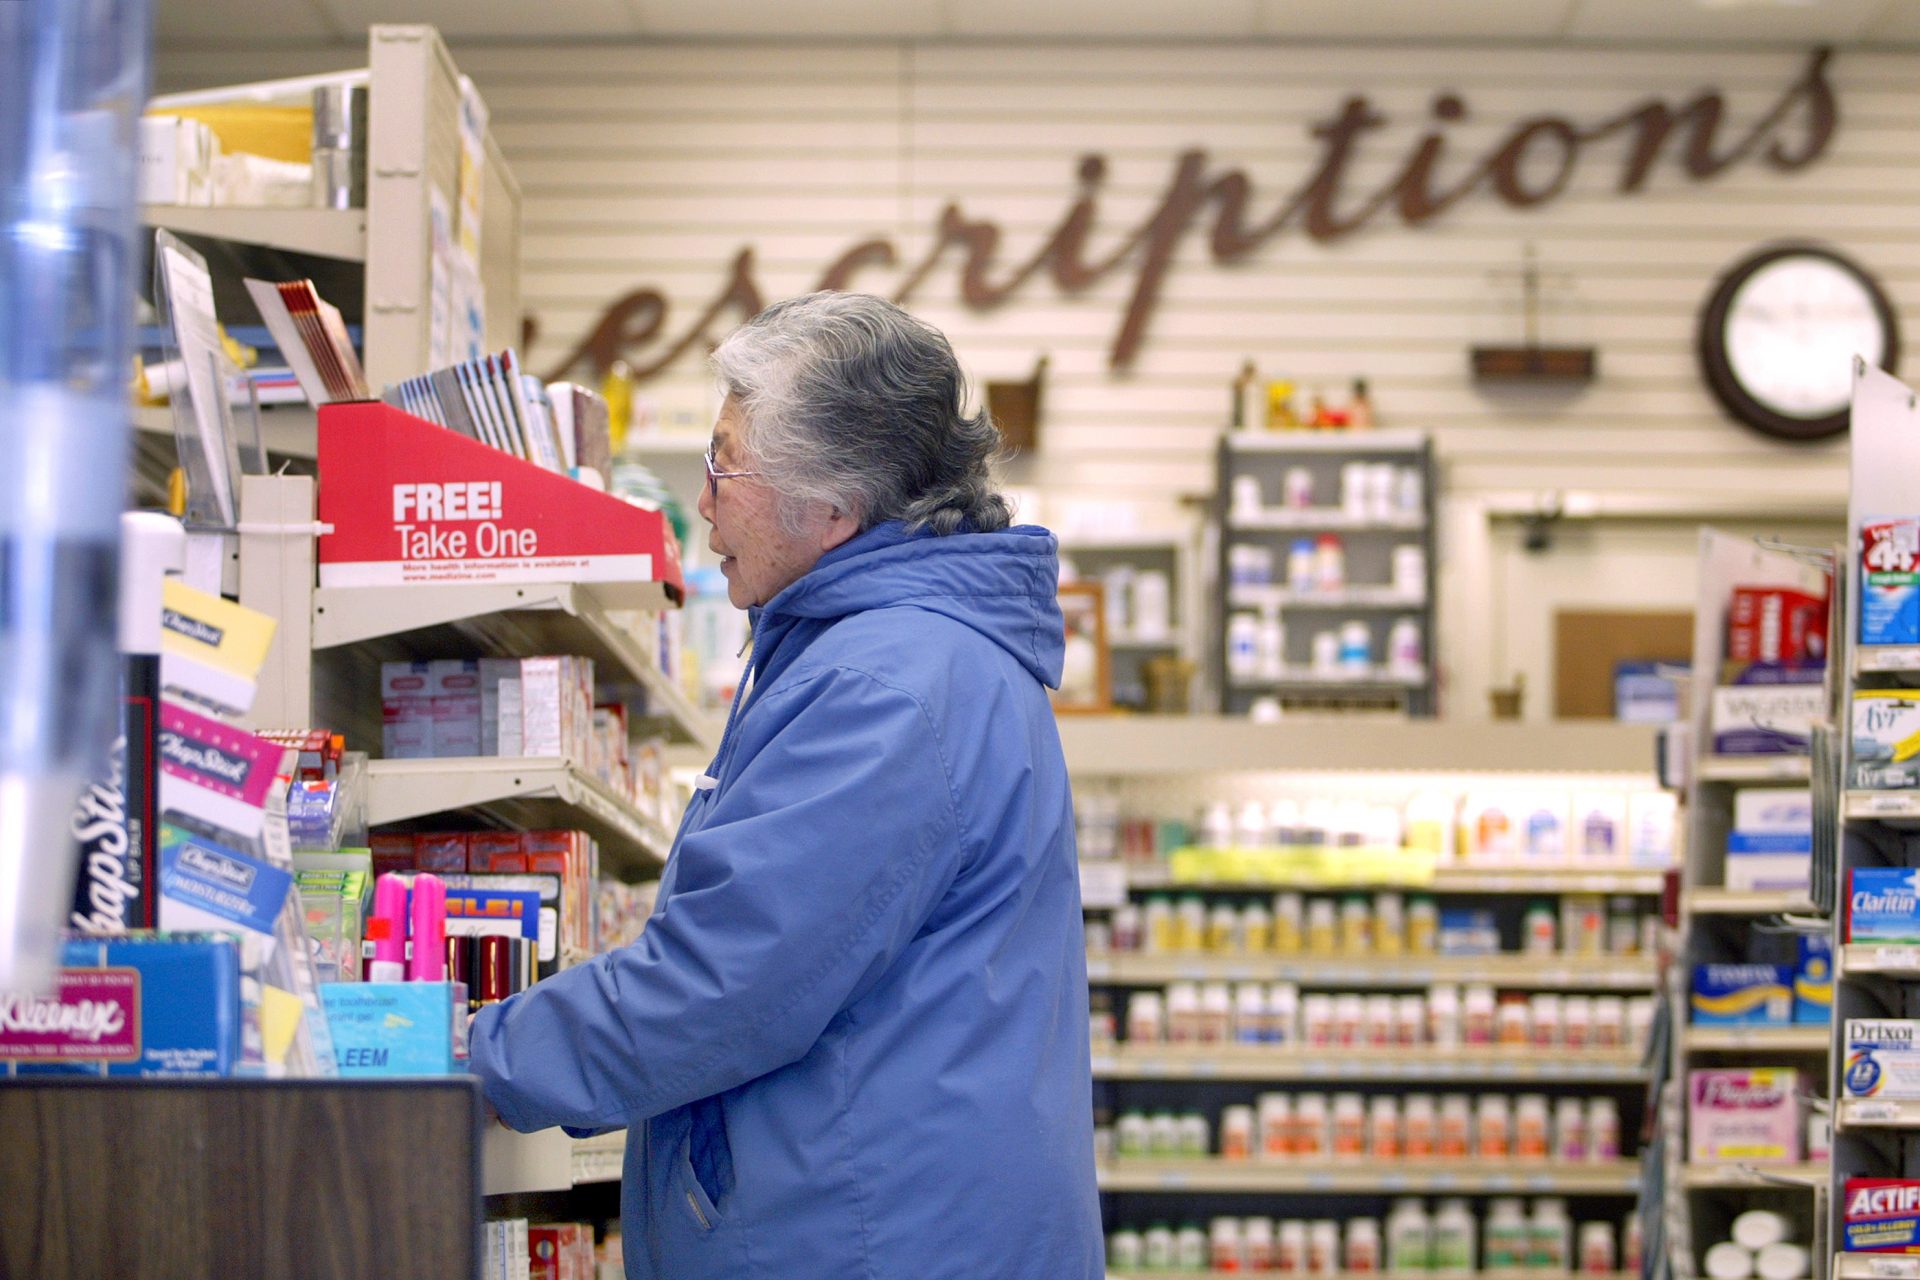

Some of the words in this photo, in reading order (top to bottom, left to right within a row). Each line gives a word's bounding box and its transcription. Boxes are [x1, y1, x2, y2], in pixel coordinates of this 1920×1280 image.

[521, 46, 1839, 382] escriptions
[393, 481, 502, 522] FREE!
[394, 524, 467, 559] Take
[476, 521, 537, 557] One
[403, 563, 427, 571] More
[431, 562, 460, 571] health
[464, 561, 518, 570] information
[523, 561, 531, 569] is
[534, 560, 576, 568] available
[159, 732, 249, 784] ChapStick
[70, 734, 139, 937] hapSti
[127, 818, 142, 857] BALM
[127, 858, 142, 883] LIP
[183, 848, 249, 886] ChapStick
[1852, 891, 1916, 913] Claritin
[0, 990, 126, 1042] Kleenex
[336, 1048, 389, 1067] LEEM
